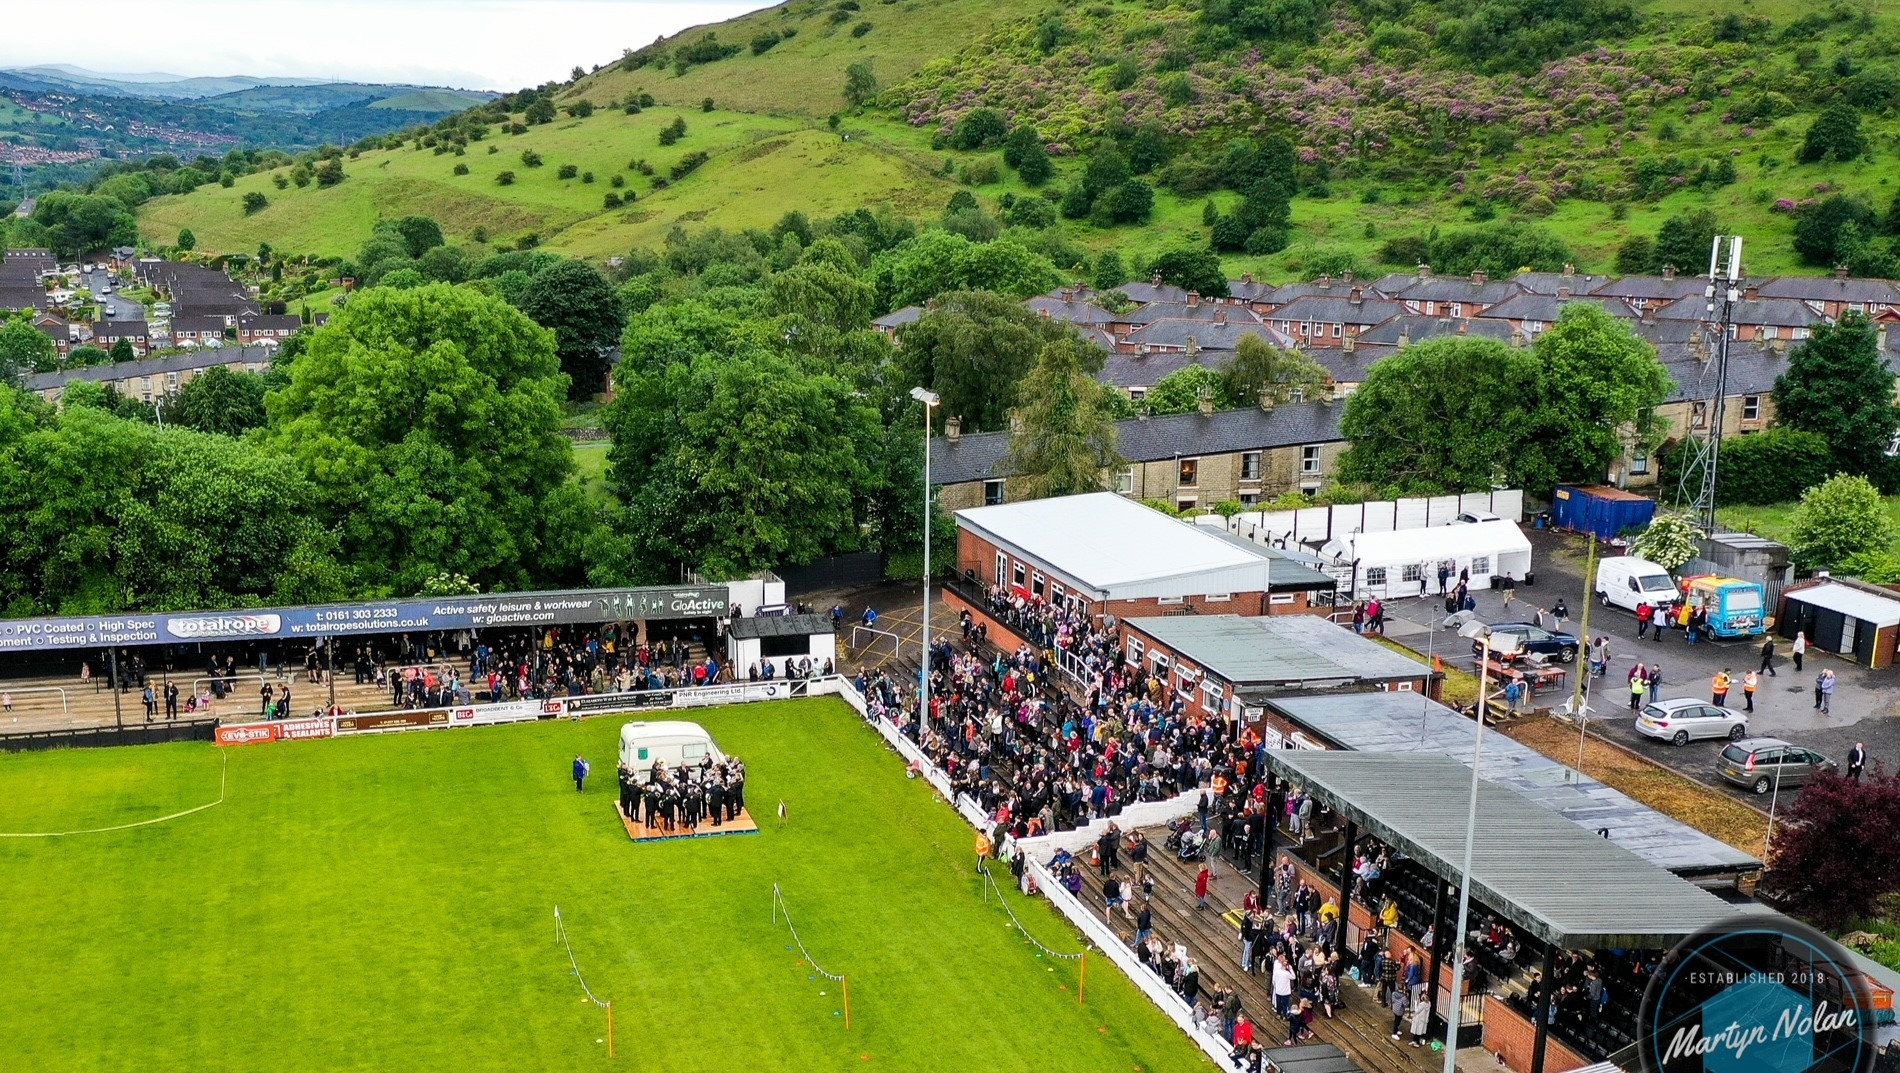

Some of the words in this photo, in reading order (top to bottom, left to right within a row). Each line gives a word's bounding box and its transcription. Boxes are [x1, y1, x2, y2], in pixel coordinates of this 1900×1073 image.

[433, 605, 465, 616] Active
[466, 603, 498, 614] safety
[499, 602, 532, 612] leisure
[534, 601, 542, 610] &
[543, 600, 593, 609] workwear
[671, 598, 725, 611] GloActive
[316, 612, 324, 620] t:
[326, 611, 350, 620] 0161
[352, 609, 372, 619] 303
[373, 608, 398, 618] 2333
[472, 616, 484, 624] w:
[486, 612, 555, 625] gloactive.com
[17, 624, 41, 635] PVC
[43, 622, 85, 633] Coated
[99, 620, 125, 632] High
[127, 619, 156, 630] Spec
[179, 618, 268, 632] totalrope
[291, 624, 304, 632] w:
[306, 617, 429, 633] totalropesolutions.co.uk
[47, 634, 87, 645] Testing
[89, 633, 98, 643] &
[100, 631, 157, 643] Inspection
[693, 689, 730, 698] Engineering
[475, 705, 509, 713] BROADBENT
[282, 721, 330, 731] ADHESIVES
[290, 729, 331, 738] SEALANTS
